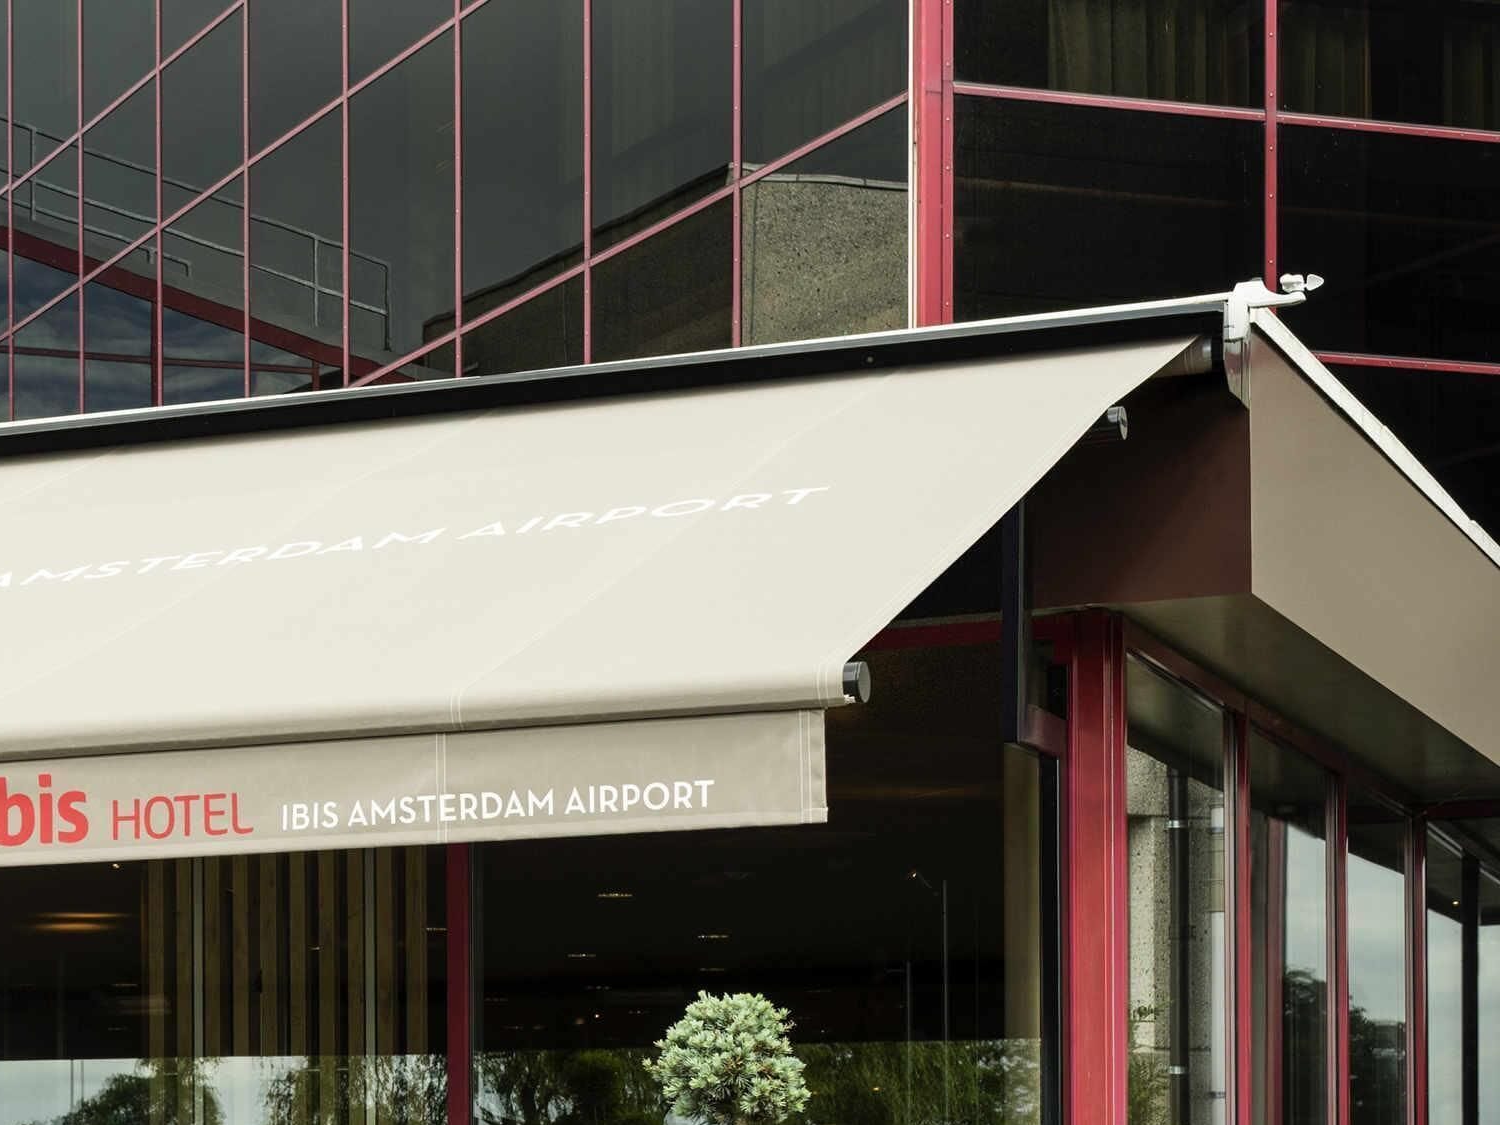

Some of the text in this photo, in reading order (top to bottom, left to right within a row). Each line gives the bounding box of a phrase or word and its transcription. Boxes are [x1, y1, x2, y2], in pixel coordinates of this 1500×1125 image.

[456, 485, 831, 540] AIRPORT
[110, 792, 254, 841] HOTEL
[282, 801, 339, 831] IBIS
[347, 788, 554, 827] AMSTERDAM
[564, 779, 715, 815] AIRPORT
